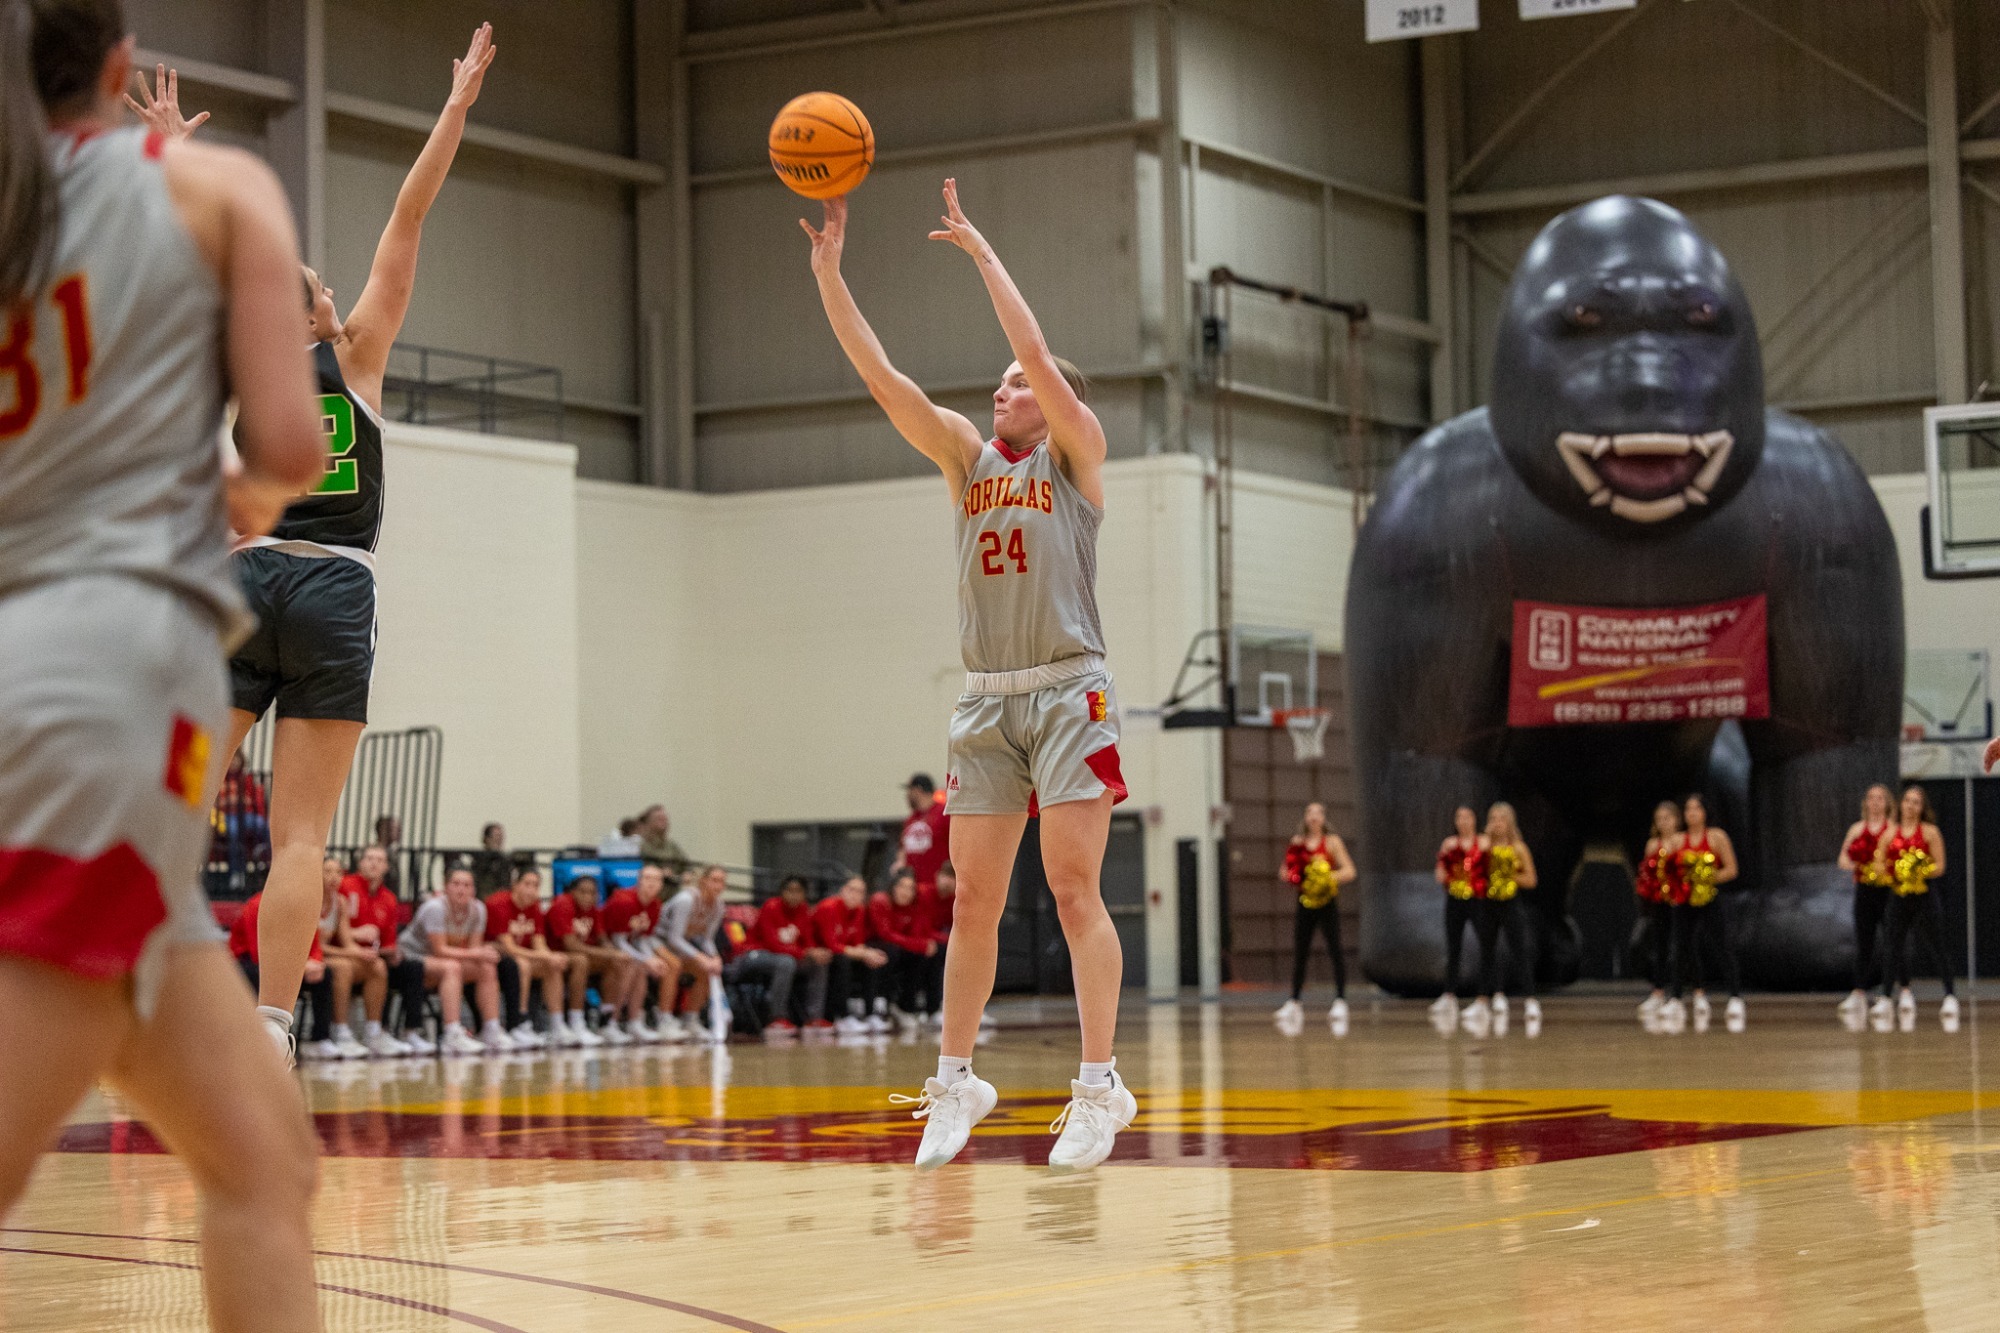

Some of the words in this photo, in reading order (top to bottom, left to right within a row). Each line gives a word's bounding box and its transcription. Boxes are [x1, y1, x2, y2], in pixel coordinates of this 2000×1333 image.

[1397, 5, 1445, 28] 2012
[978, 528, 1028, 575] 24
[1578, 609, 1738, 632] COMMUNITY
[1578, 631, 1710, 650] NATIONAL
